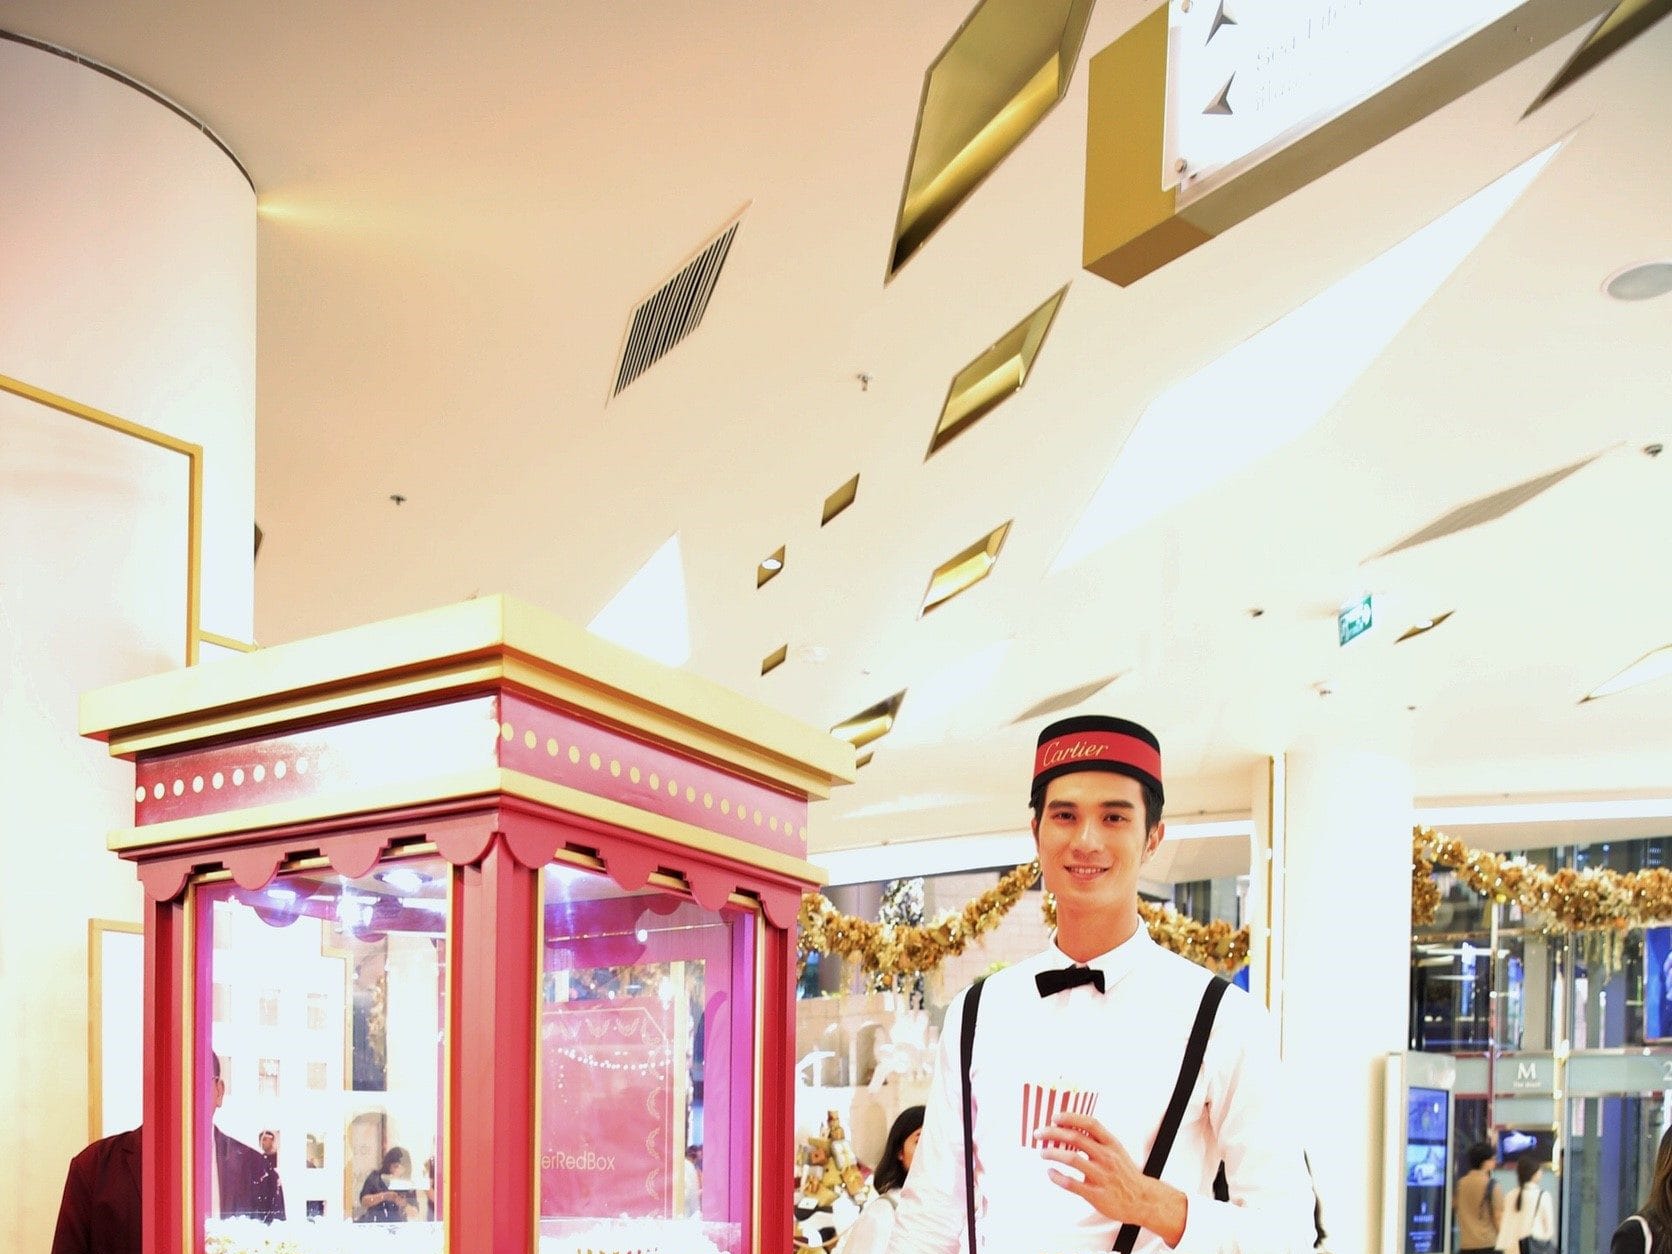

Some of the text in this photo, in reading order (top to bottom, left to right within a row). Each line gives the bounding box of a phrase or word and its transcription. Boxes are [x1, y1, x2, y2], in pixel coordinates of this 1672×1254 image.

[1043, 740, 1109, 767] Cartier
[1517, 1062, 1536, 1080] M
[541, 1150, 616, 1170] erRedBox
